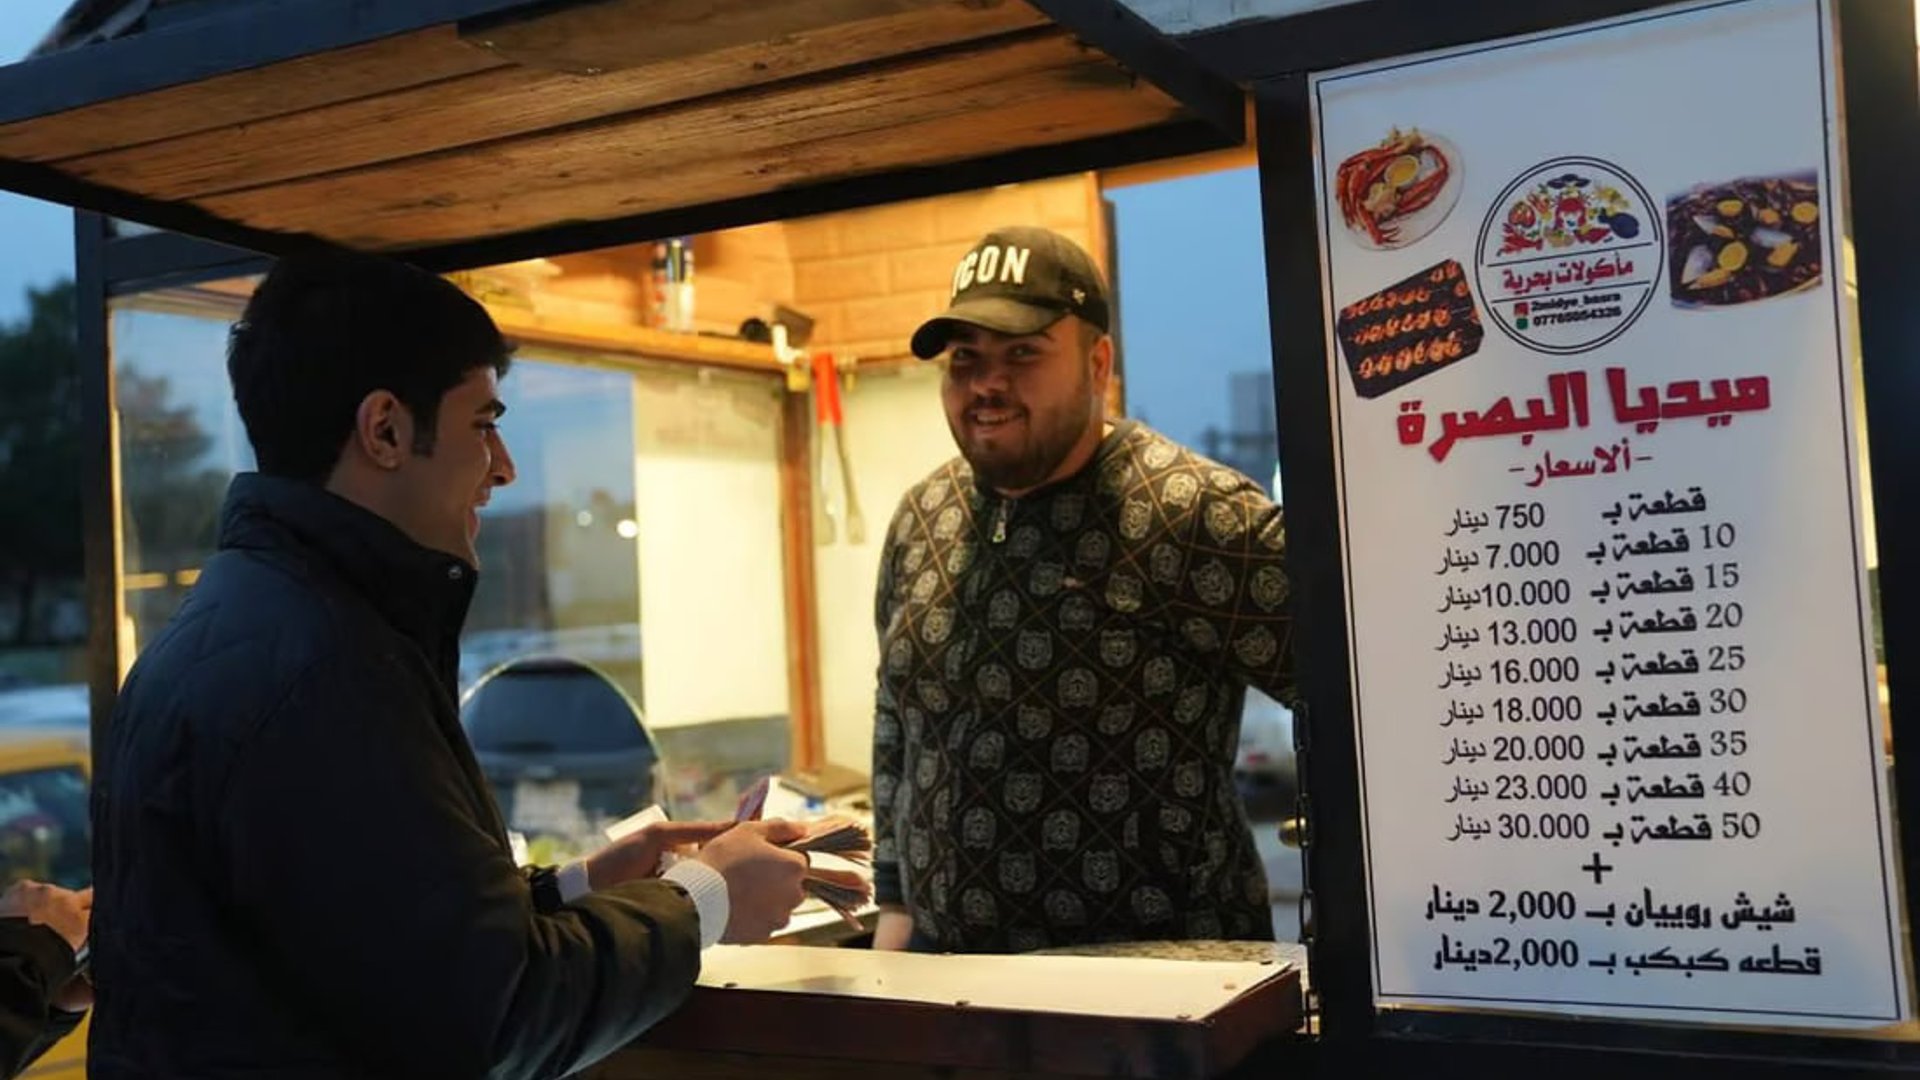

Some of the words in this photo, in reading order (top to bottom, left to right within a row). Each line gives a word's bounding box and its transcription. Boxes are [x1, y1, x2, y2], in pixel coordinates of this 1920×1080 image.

[1502, 268, 1553, 295] بحرية
[1555, 251, 1634, 285] مأكولات
[1604, 367, 1771, 435] ميديا
[1396, 370, 1591, 464] البصرة
[1495, 502, 1546, 530] 750
[1628, 486, 1707, 522] قطعة
[1443, 508, 1490, 537] دينار
[1700, 523, 1735, 549] 10
[1485, 540, 1560, 570] 7.000
[1612, 527, 1690, 562] قطعة
[1435, 547, 1480, 575] دينار
[1616, 566, 1694, 600] قطعة
[1704, 562, 1740, 589] 15
[1619, 606, 1698, 640] قطعة
[1705, 602, 1743, 629] 20
[1435, 623, 1480, 651] دينار
[1487, 617, 1578, 646] 13.000
[1490, 656, 1580, 684] 16.000
[1621, 648, 1700, 681] قطعة
[1708, 645, 1745, 671] 25
[1438, 661, 1482, 689] دينار
[1439, 699, 1484, 727] دينار
[1492, 695, 1582, 723] 18.000
[1623, 690, 1701, 723] قطعة
[1710, 688, 1747, 715] 30
[1442, 737, 1487, 765] دينار
[1493, 734, 1585, 762] 20.000
[1623, 732, 1702, 764] قطعة
[1710, 730, 1747, 757] 35
[1445, 775, 1489, 803] دينار
[1495, 774, 1587, 801] 23.000
[1627, 773, 1705, 804] قطعة
[1712, 771, 1751, 797] 40
[1446, 813, 1491, 842] دينار
[1498, 813, 1590, 840] 30.000
[1630, 813, 1713, 844] قطعة
[1722, 812, 1761, 839] 50
[1425, 884, 1480, 922] دينار
[1488, 890, 1576, 924] 2,000
[1720, 891, 1796, 931] شيش
[1624, 946, 1730, 979] كبكب
[1738, 943, 1822, 977] قطعه
